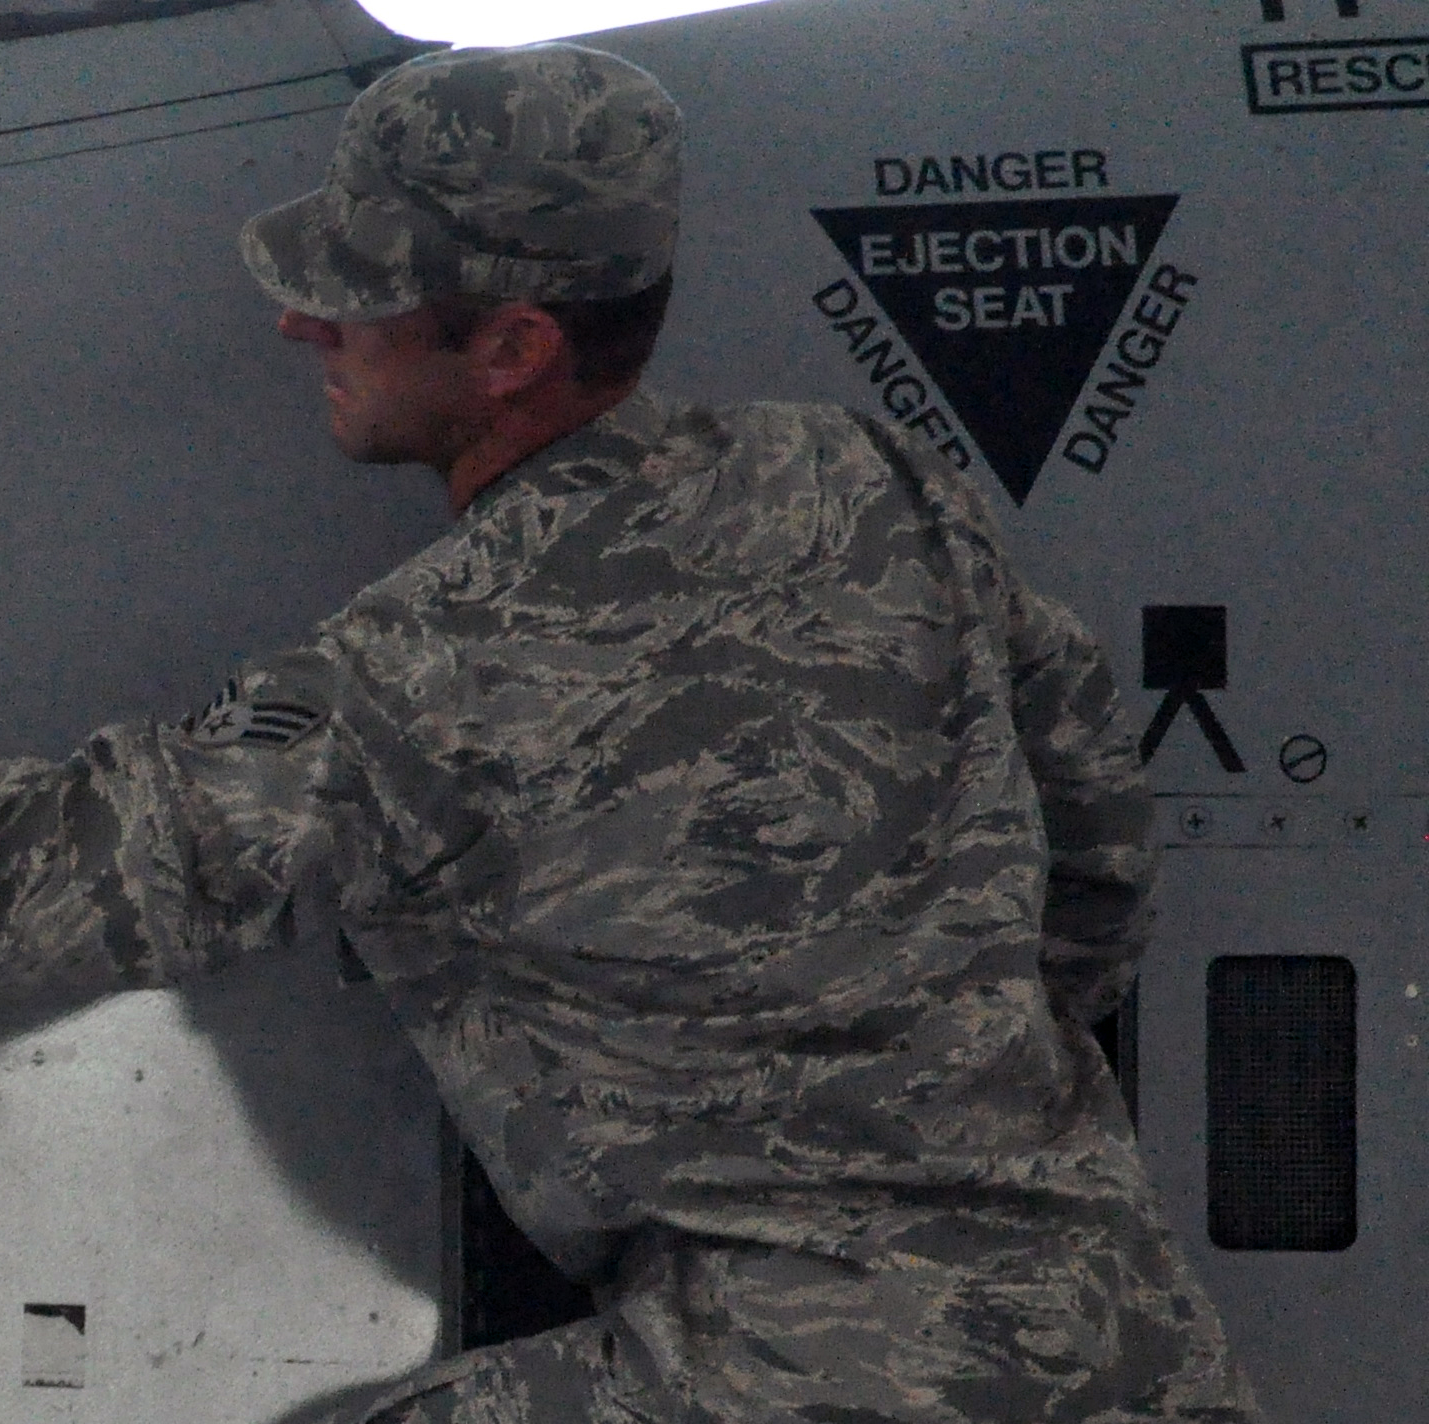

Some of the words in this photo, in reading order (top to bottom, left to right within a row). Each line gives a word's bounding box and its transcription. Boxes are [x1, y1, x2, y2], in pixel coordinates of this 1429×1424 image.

[1268, 54, 1429, 96] RESC
[873, 149, 1110, 196] DANGER
[860, 225, 1139, 276] EJECTION
[933, 285, 1074, 332] SEAT
[1062, 262, 1199, 475] DANGER
